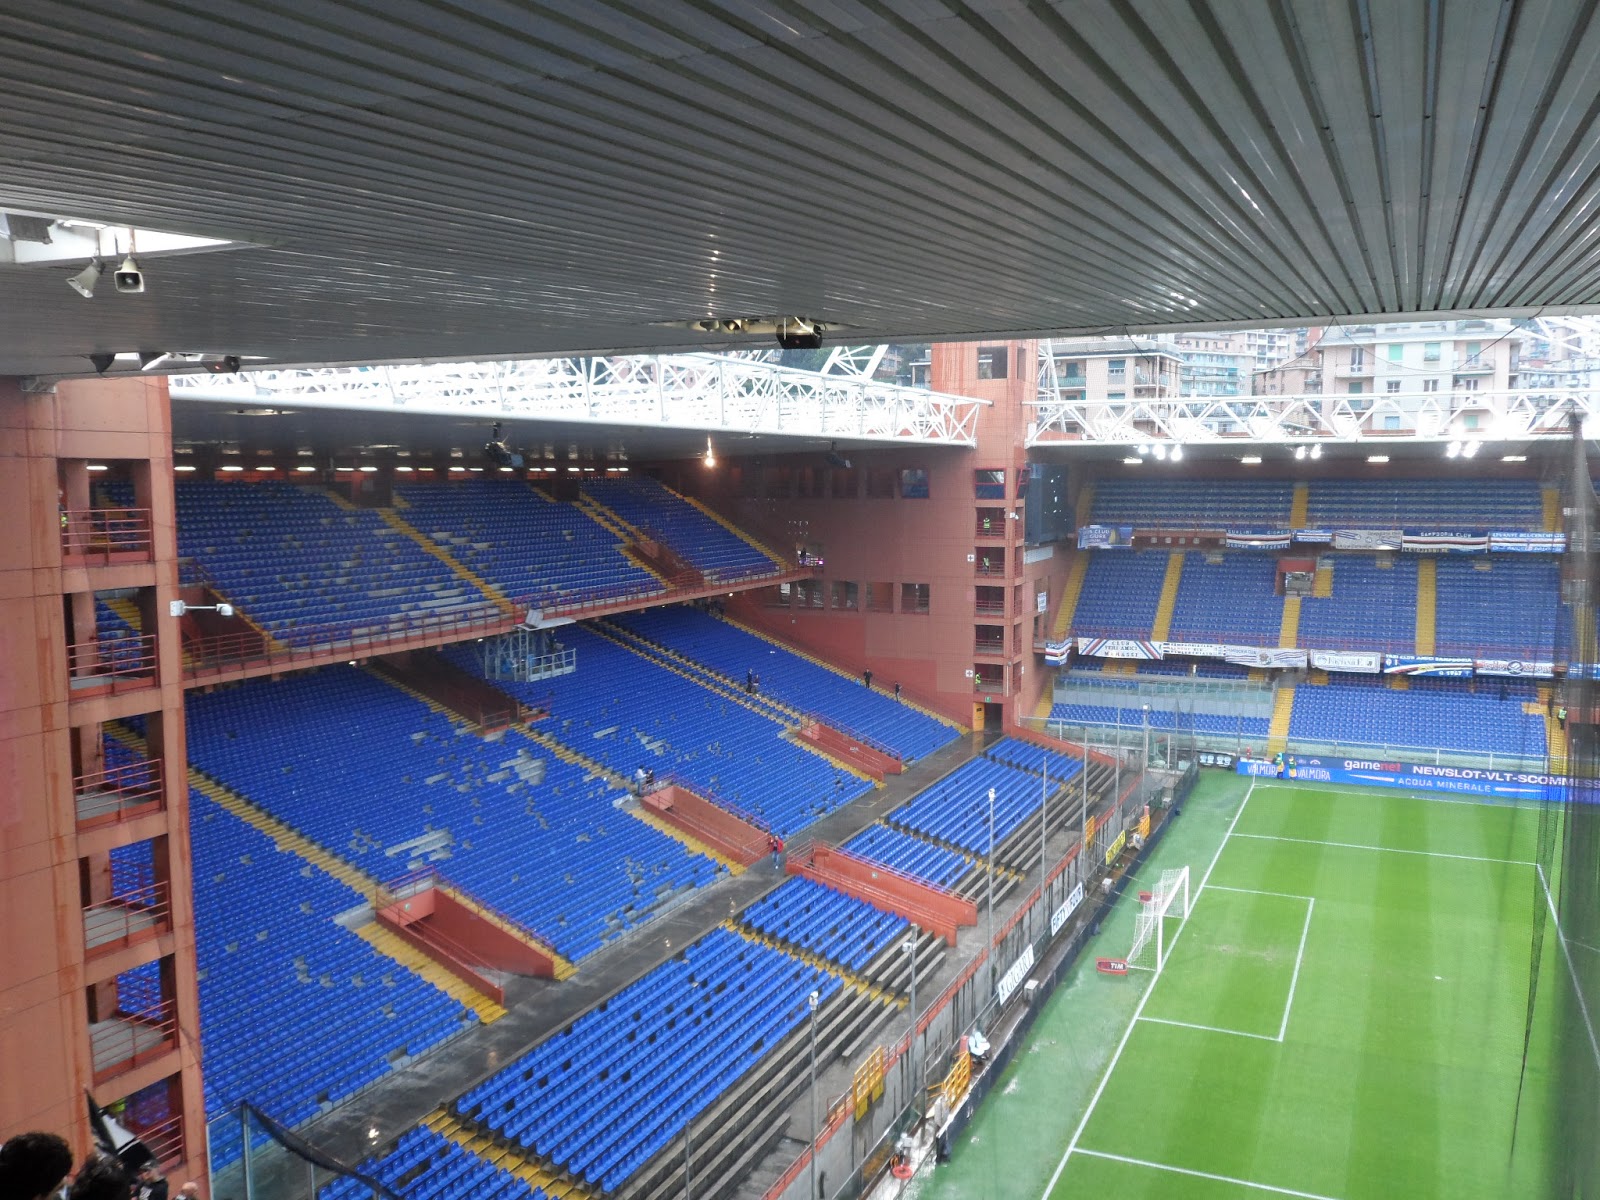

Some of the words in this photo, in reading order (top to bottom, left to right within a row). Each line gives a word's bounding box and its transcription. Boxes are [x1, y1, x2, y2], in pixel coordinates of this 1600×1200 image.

[1344, 759, 1401, 773] gamenet
[1297, 767, 1331, 780] VALMORA
[1397, 778, 1433, 787] ACQUA
[1436, 780, 1491, 793] MINERALE
[1110, 962, 1124, 970] TIM
